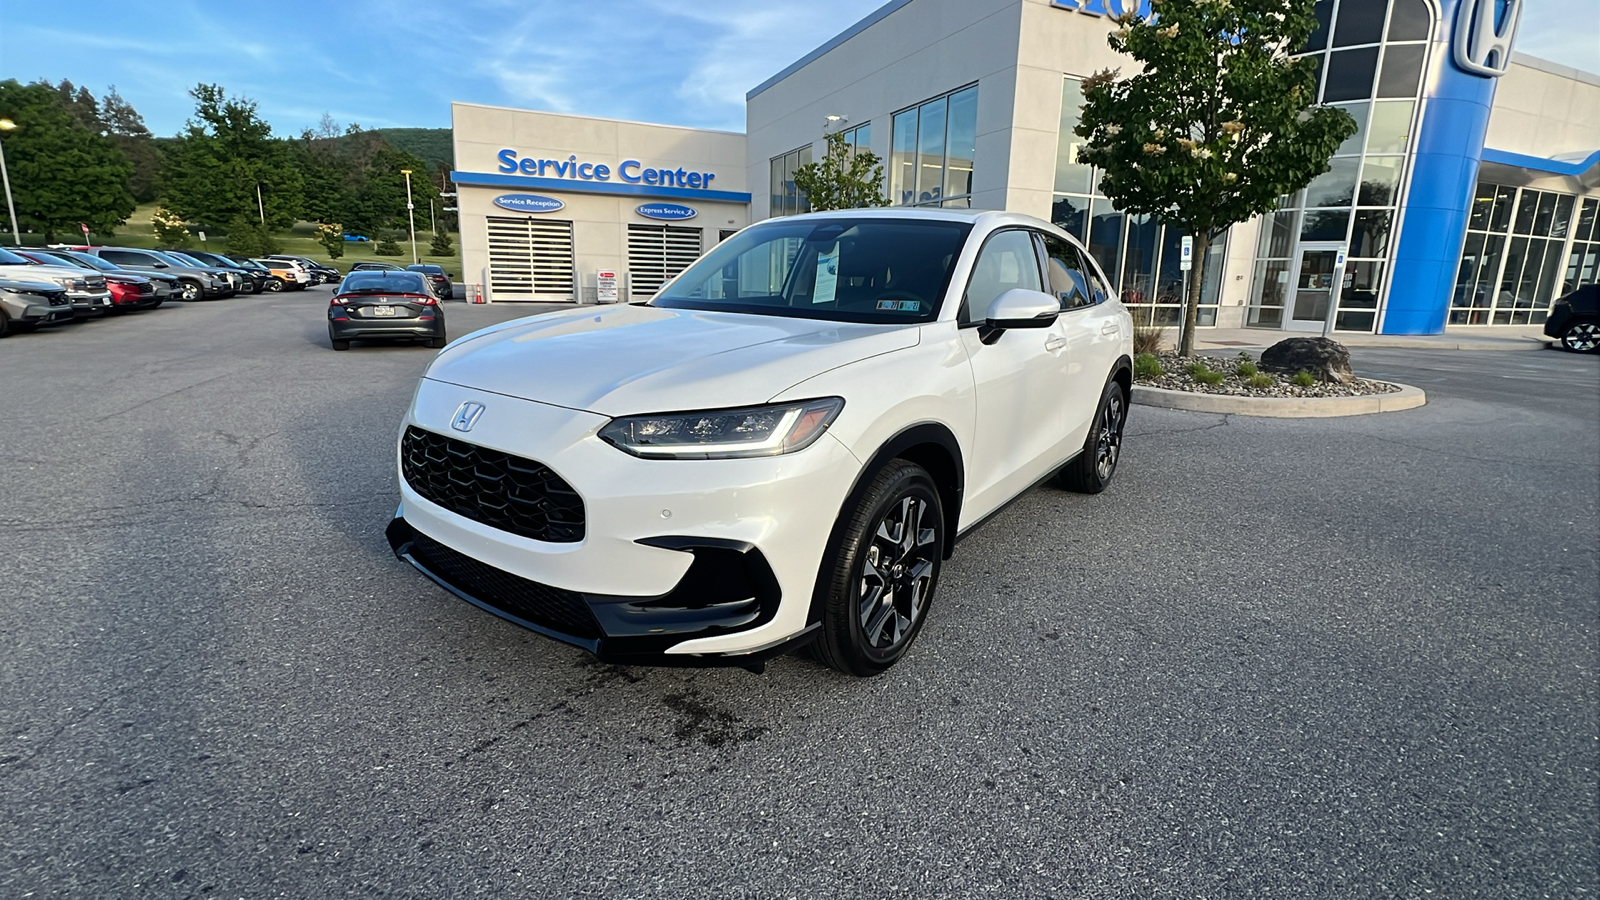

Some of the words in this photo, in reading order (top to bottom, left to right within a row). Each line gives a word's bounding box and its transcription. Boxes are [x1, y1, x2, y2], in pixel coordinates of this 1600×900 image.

[497, 149, 610, 180] Service
[618, 160, 715, 188] Center
[499, 197, 525, 205] Service
[526, 199, 560, 208] Reception
[640, 206, 662, 214] Express
